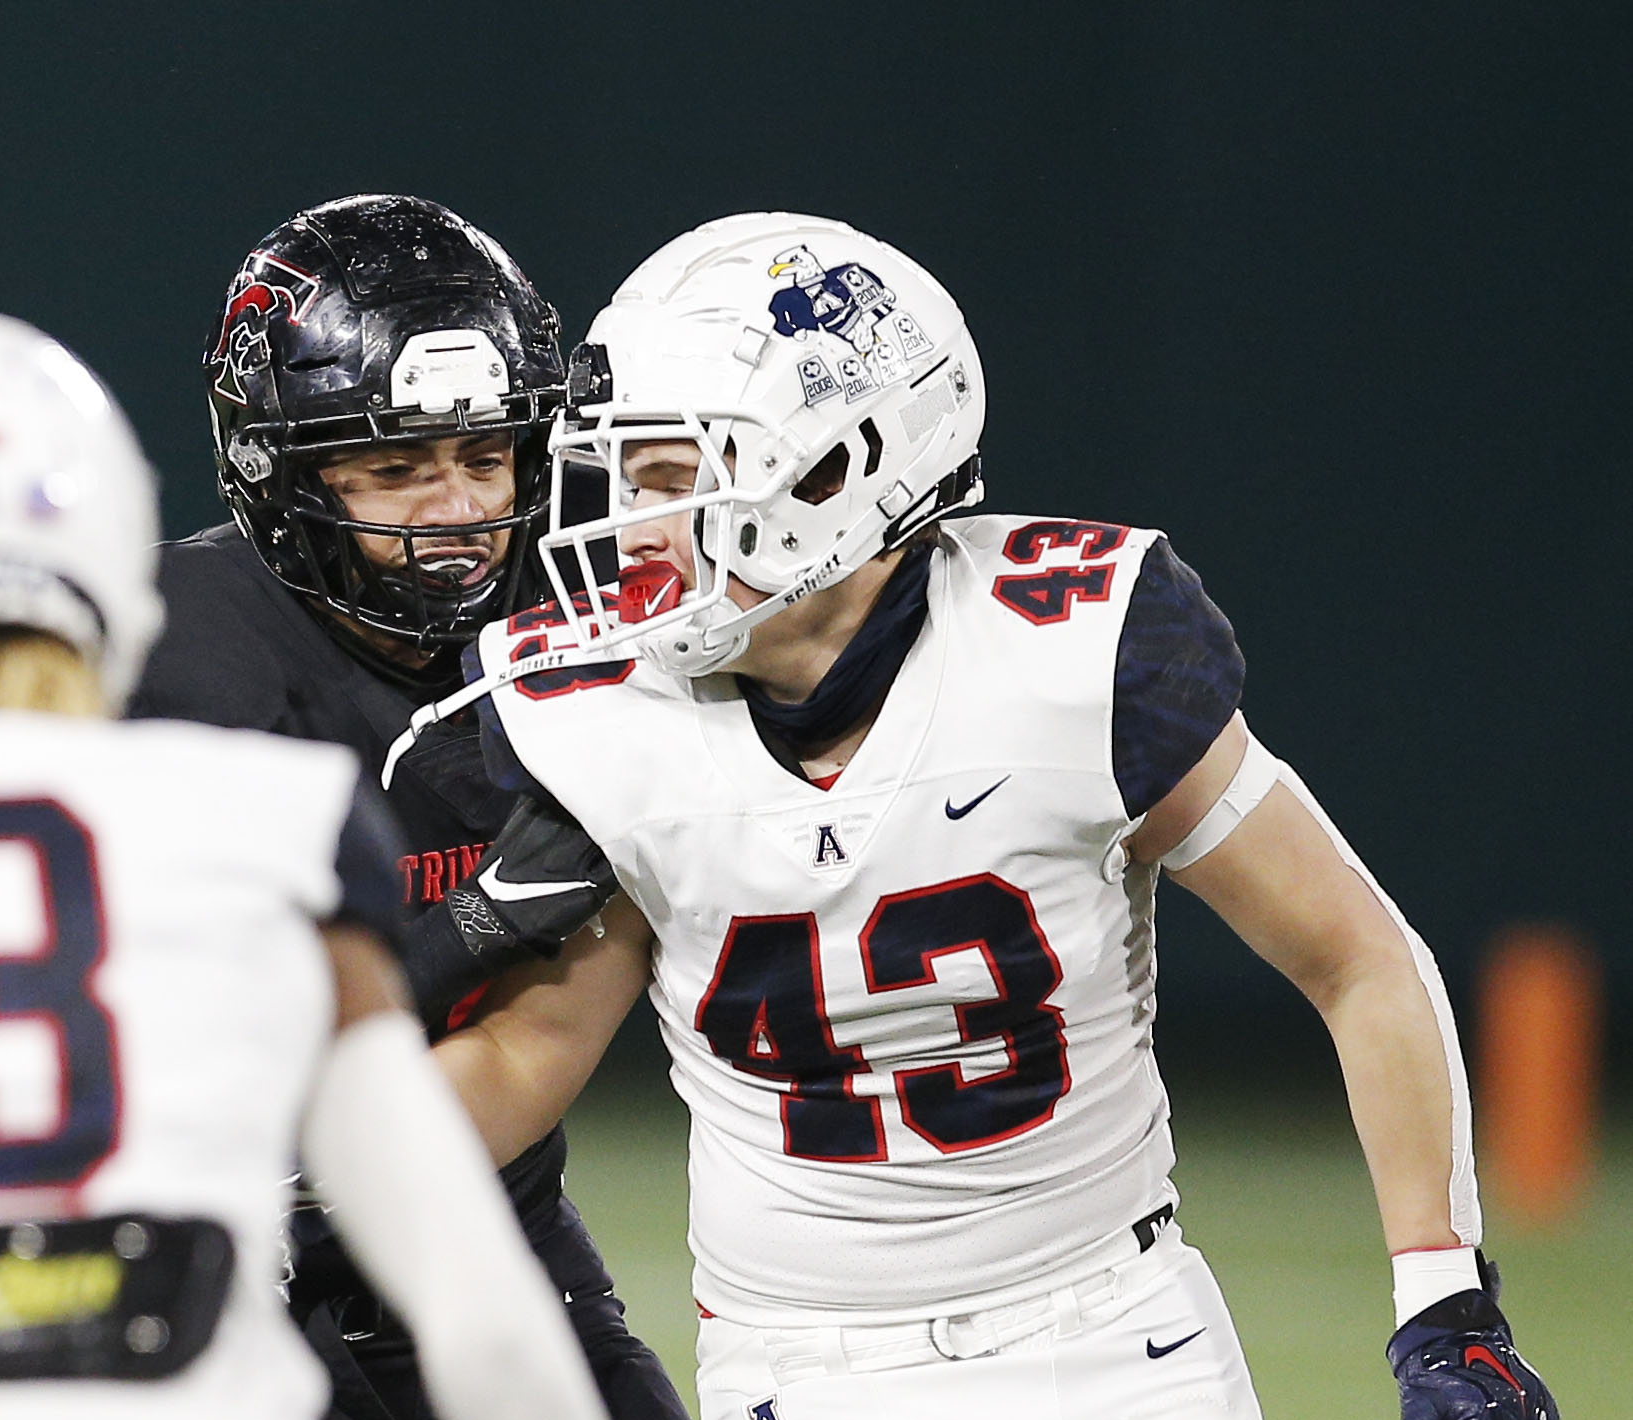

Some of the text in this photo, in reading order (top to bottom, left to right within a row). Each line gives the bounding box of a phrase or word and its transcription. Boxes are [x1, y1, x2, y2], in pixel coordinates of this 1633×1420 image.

[855, 285, 881, 306] 2017
[904, 333, 928, 351] 2014
[805, 376, 834, 398] 2008
[845, 375, 873, 397] 2012
[991, 519, 1132, 627] 43
[815, 824, 848, 866] A
[396, 841, 495, 906] TRIN
[695, 871, 1072, 1163] 43
